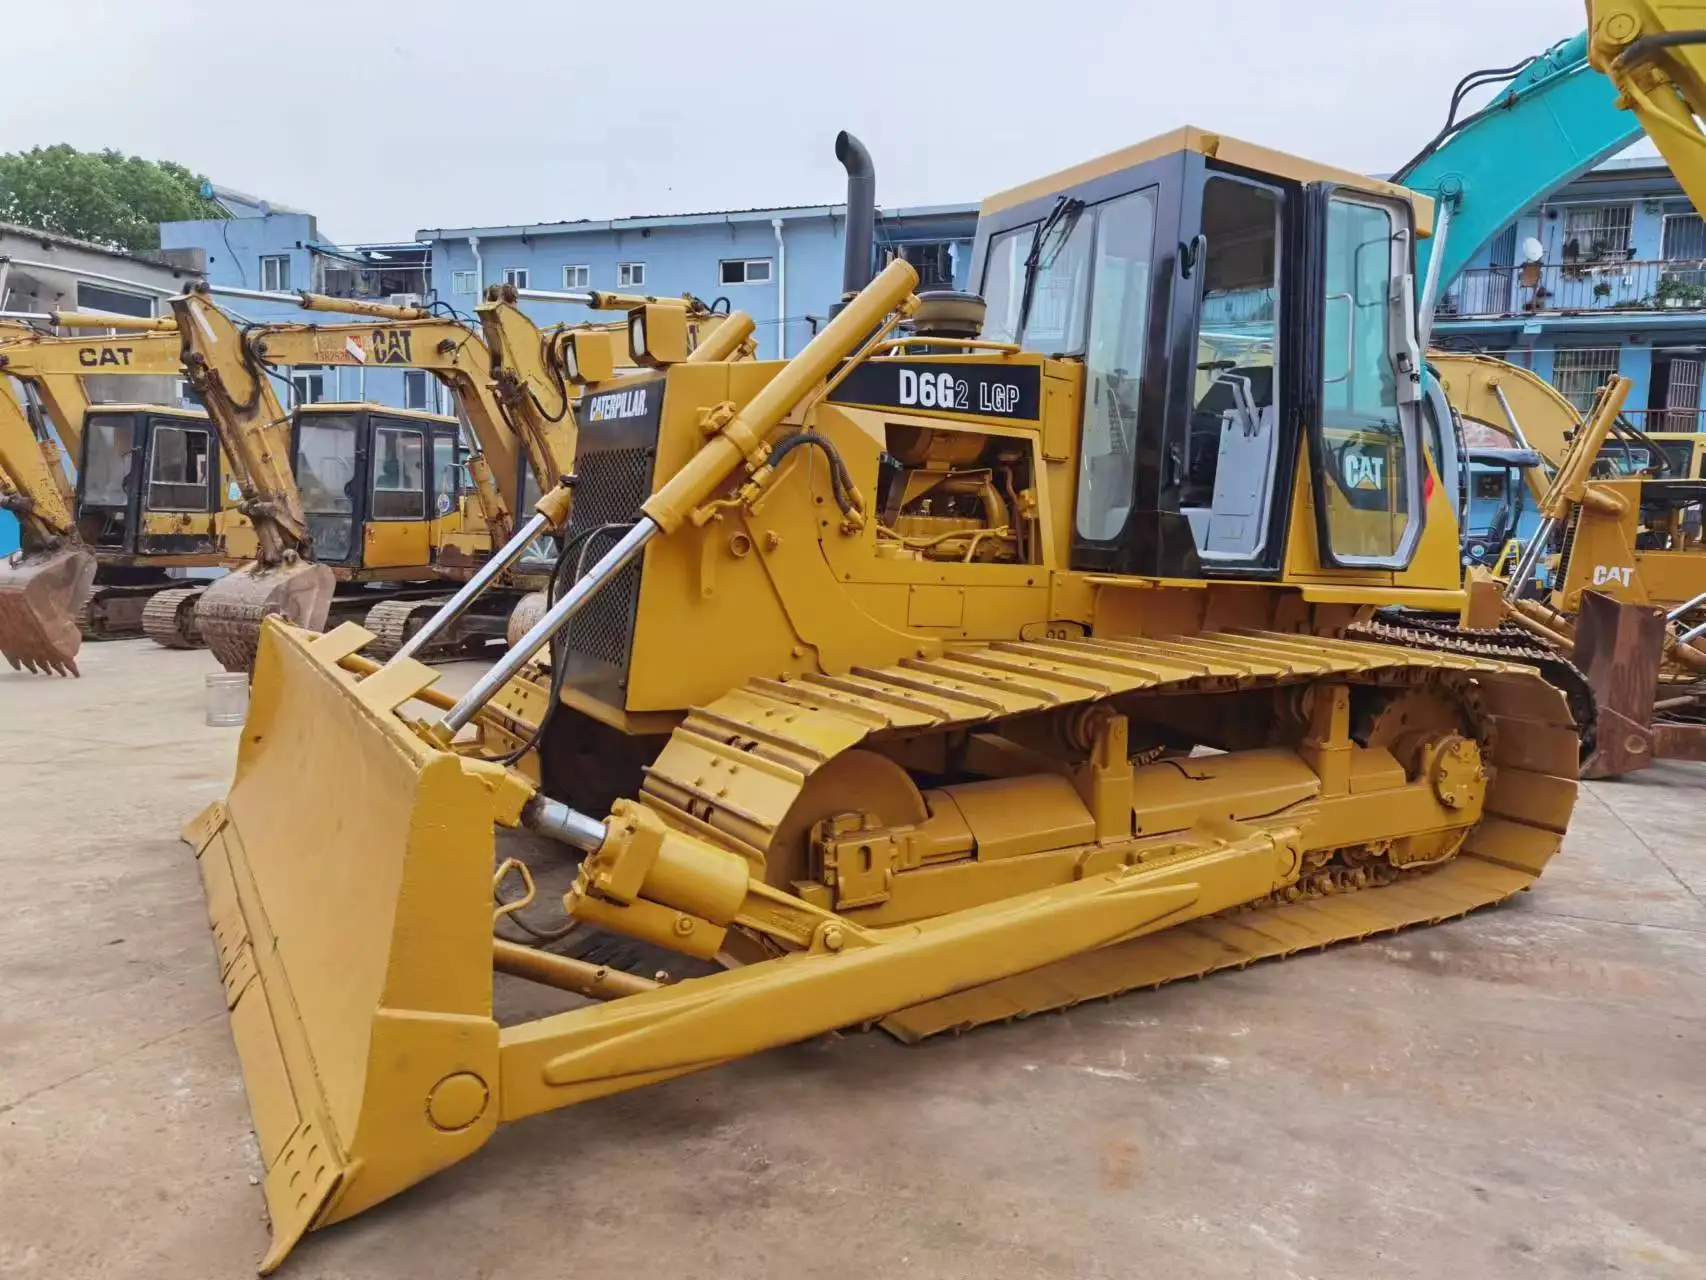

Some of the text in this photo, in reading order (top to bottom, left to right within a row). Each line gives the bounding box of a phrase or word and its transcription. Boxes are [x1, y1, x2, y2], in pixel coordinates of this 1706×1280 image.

[79, 347, 133, 366] CAT
[372, 330, 412, 364] CAT
[899, 368, 1020, 412] D6G2 LGP
[1345, 454, 1384, 490] CAT
[1592, 564, 1635, 588] CAT
